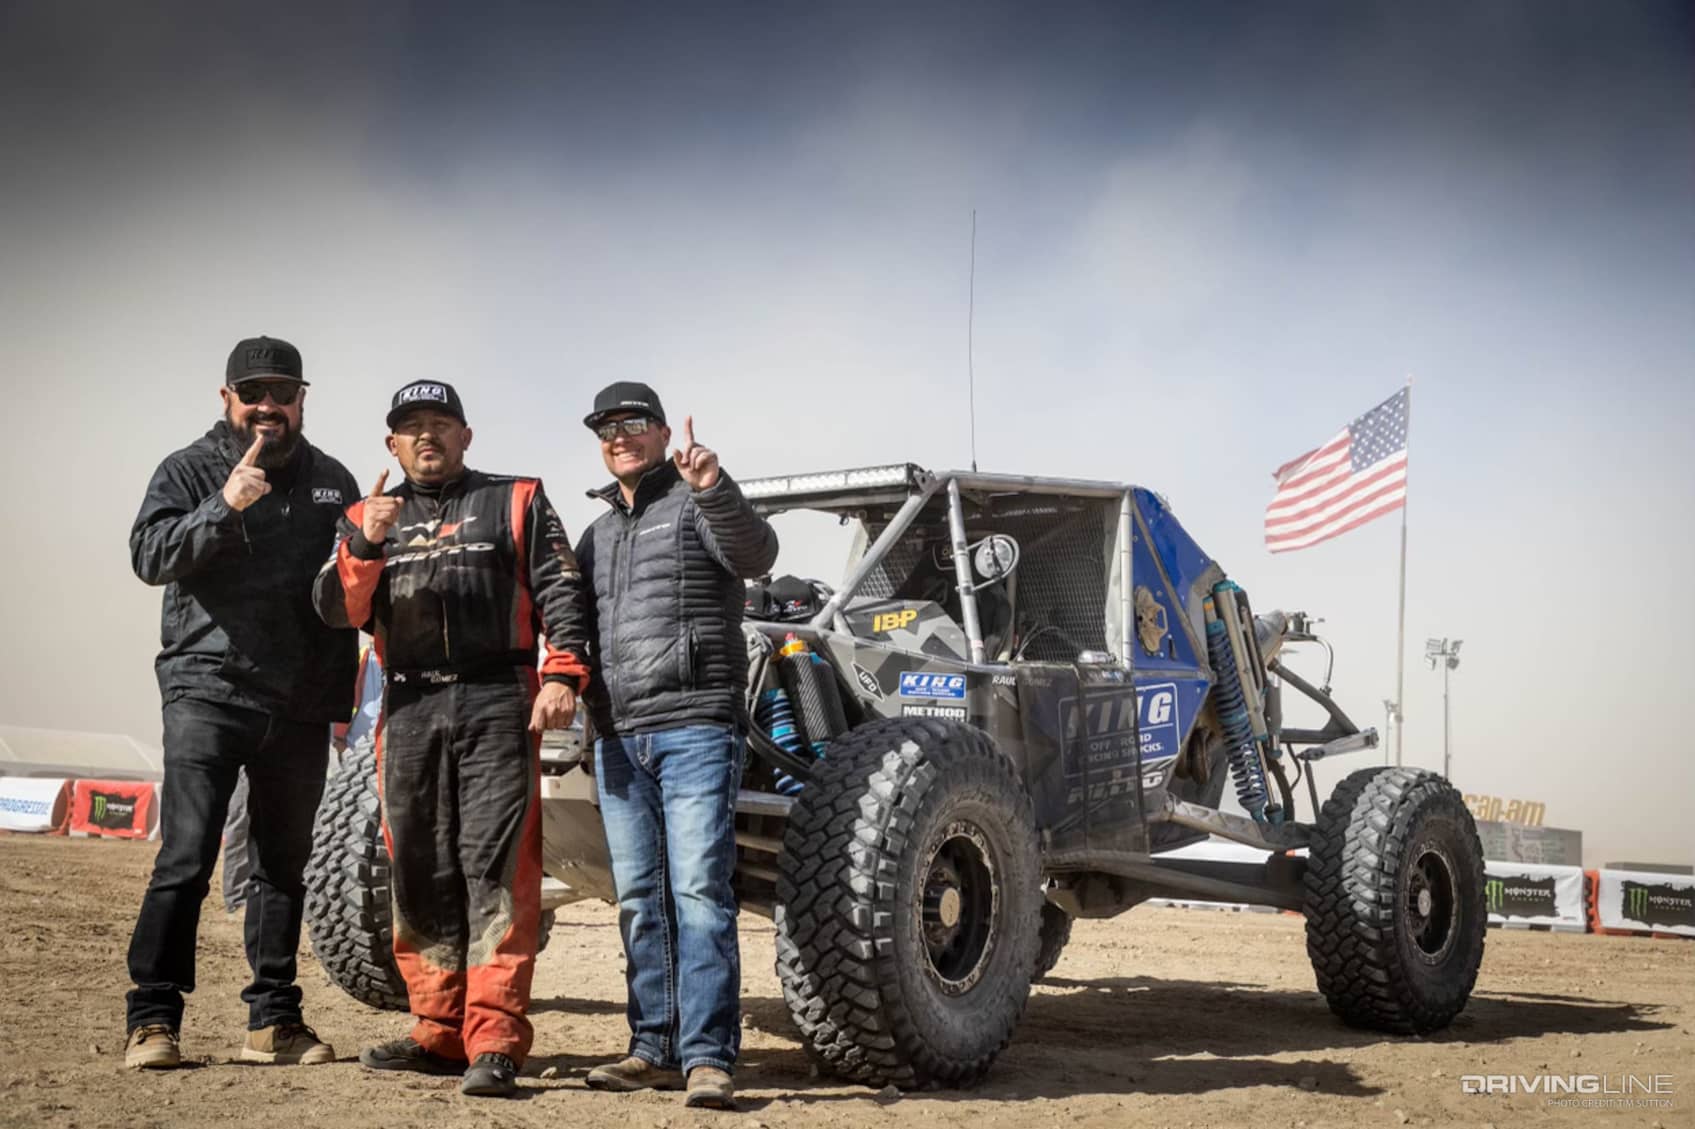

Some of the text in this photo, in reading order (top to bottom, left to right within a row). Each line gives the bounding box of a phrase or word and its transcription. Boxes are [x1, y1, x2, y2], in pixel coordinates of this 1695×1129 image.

[402, 384, 442, 399] KING
[903, 675, 964, 688] KING
[992, 675, 1017, 686] RAUL
[903, 706, 966, 718] METHOD
[1065, 692, 1173, 740] KING
[1090, 740, 1112, 752] OFF
[1121, 743, 1161, 759] SHCKS
[1504, 887, 1552, 898] MONSTER
[1649, 896, 1692, 908] MONSTER
